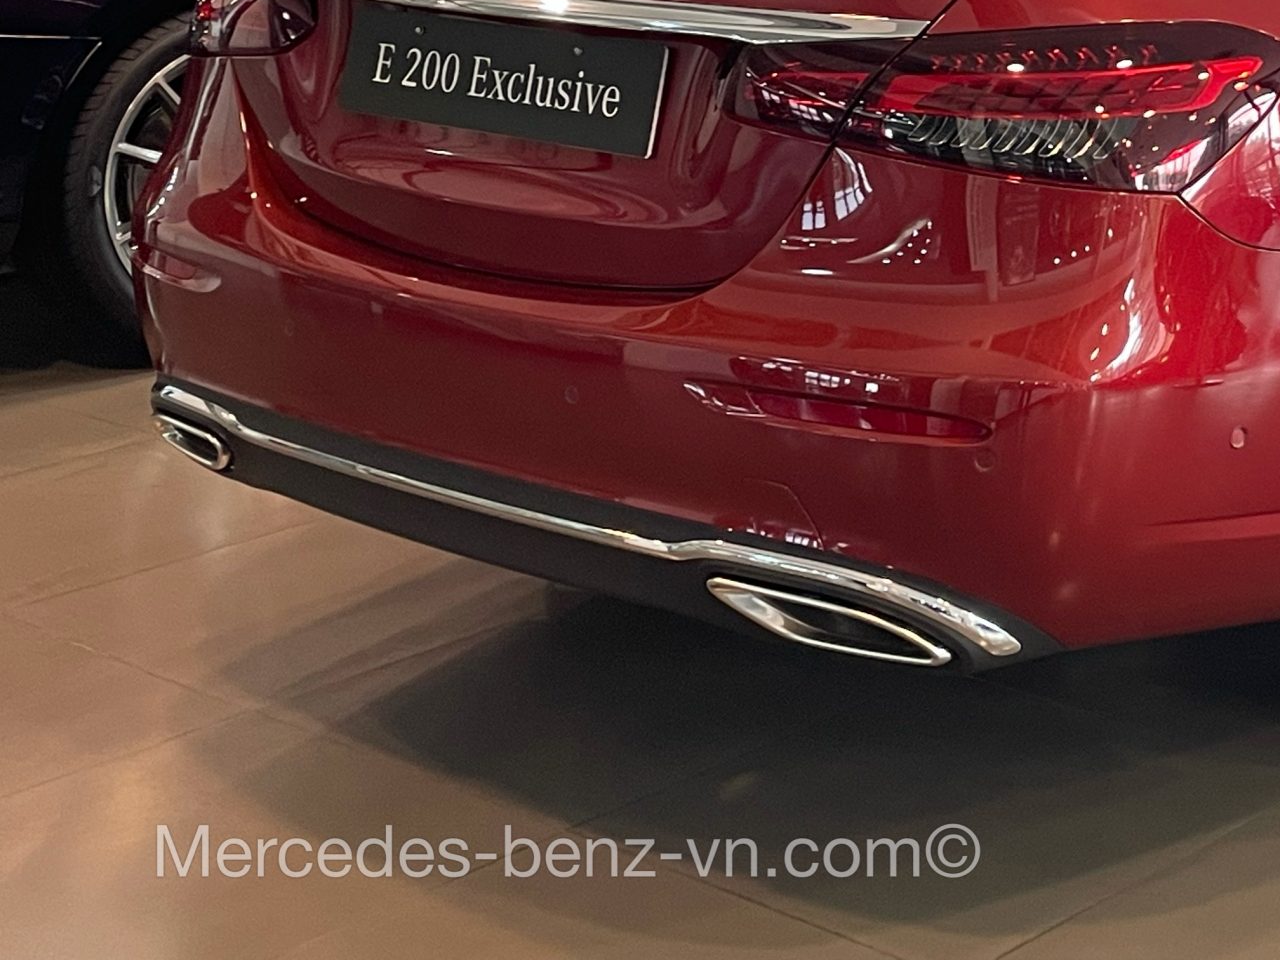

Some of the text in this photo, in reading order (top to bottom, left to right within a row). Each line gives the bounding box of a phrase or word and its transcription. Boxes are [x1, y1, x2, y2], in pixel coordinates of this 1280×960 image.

[372, 42, 622, 118] E 200 Exclusive
